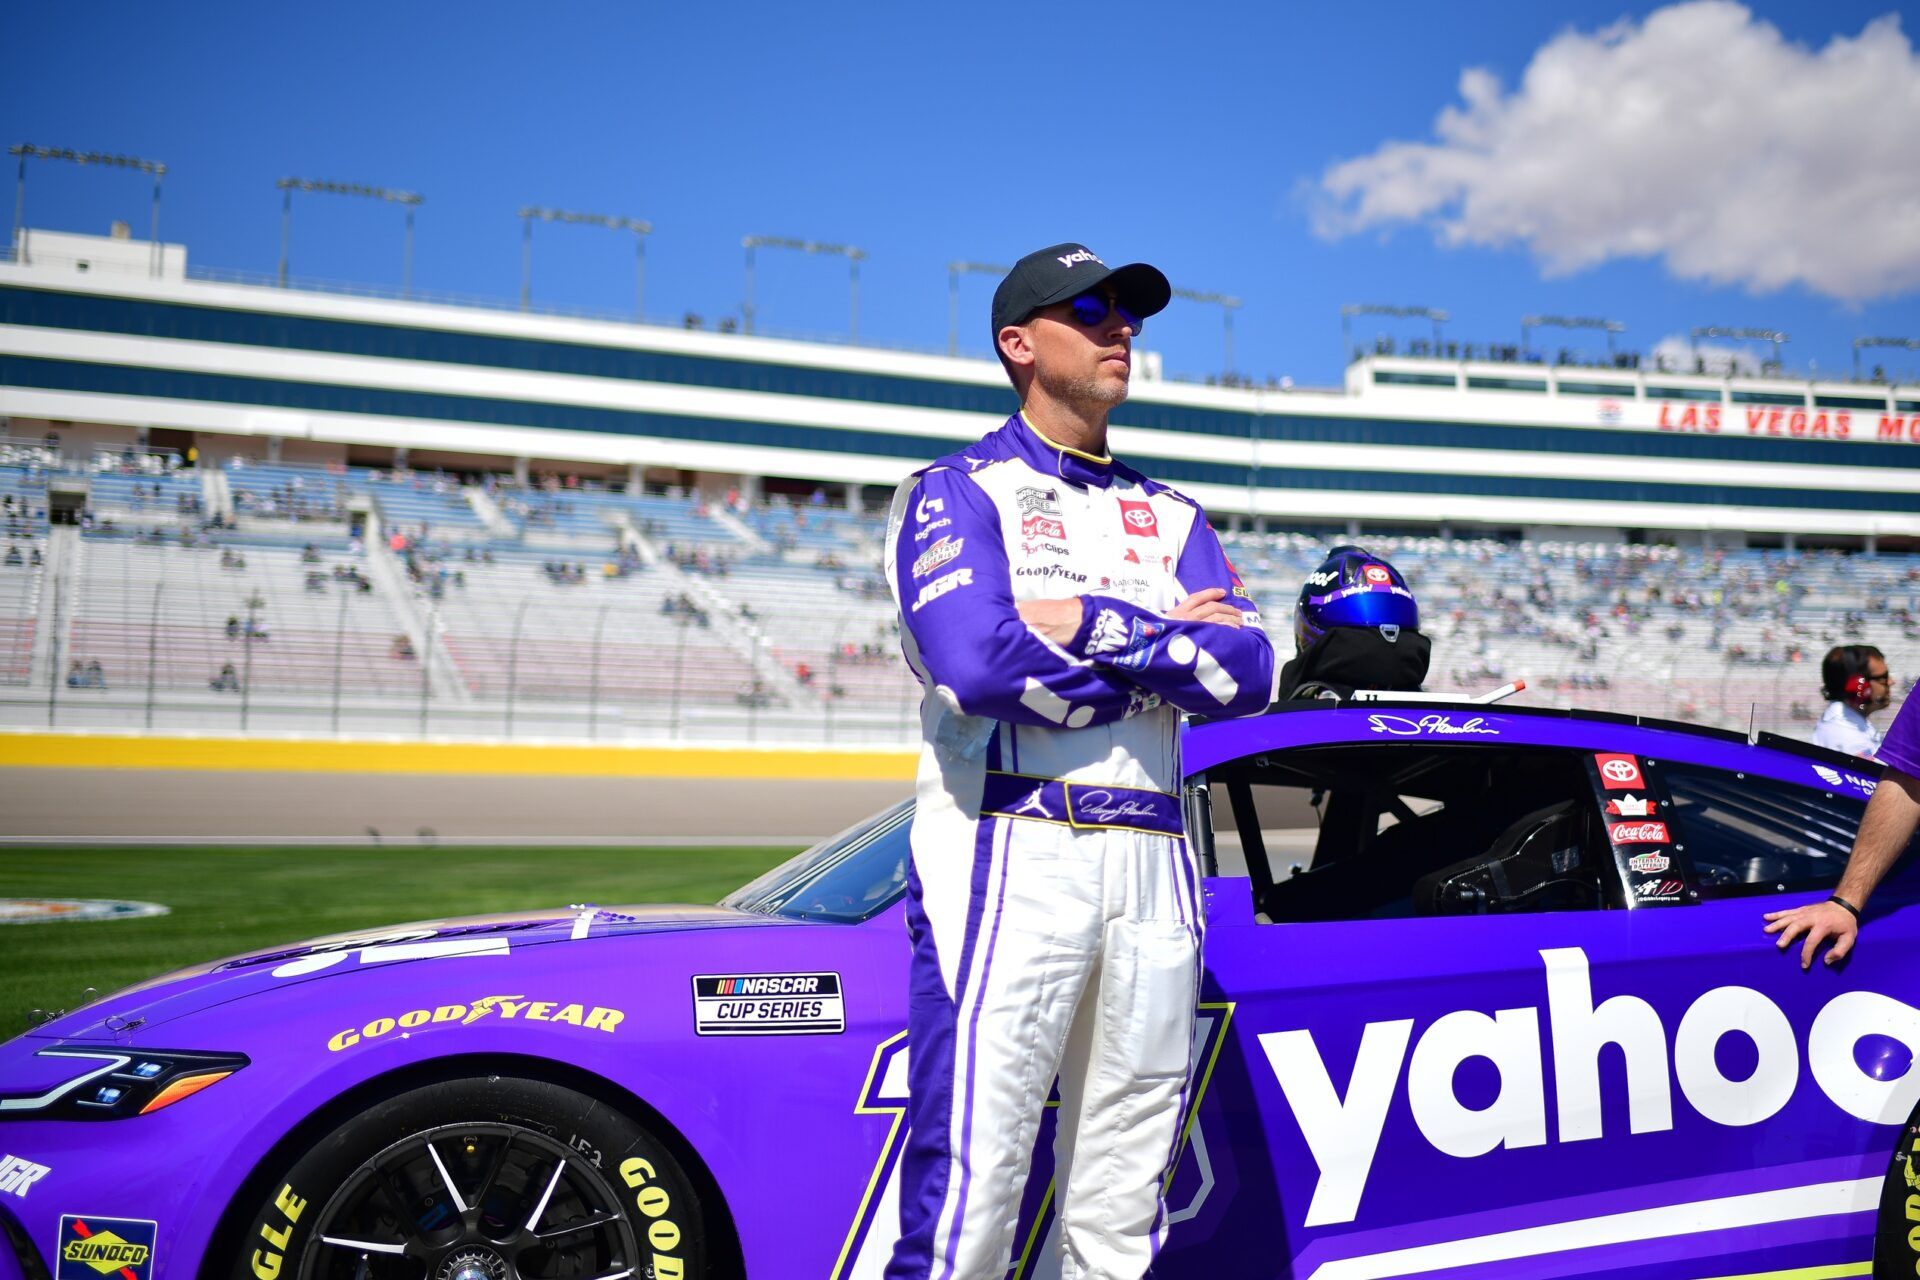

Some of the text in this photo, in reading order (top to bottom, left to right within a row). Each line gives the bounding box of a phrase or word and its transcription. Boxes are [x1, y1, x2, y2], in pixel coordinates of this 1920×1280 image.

[1658, 401, 1721, 434] LAS
[1744, 405, 1850, 440] VEGAS
[1016, 564, 1087, 583] GOODYEAR
[912, 568, 973, 612] JGR
[1612, 824, 1664, 841] Coca-Cola
[742, 978, 819, 994] NASCAR
[717, 1001, 823, 1018] CUP SERIES
[327, 994, 625, 1051] GOODYEAR
[1257, 946, 1920, 1227] yahoo
[66, 1242, 147, 1264] SUNOCO
